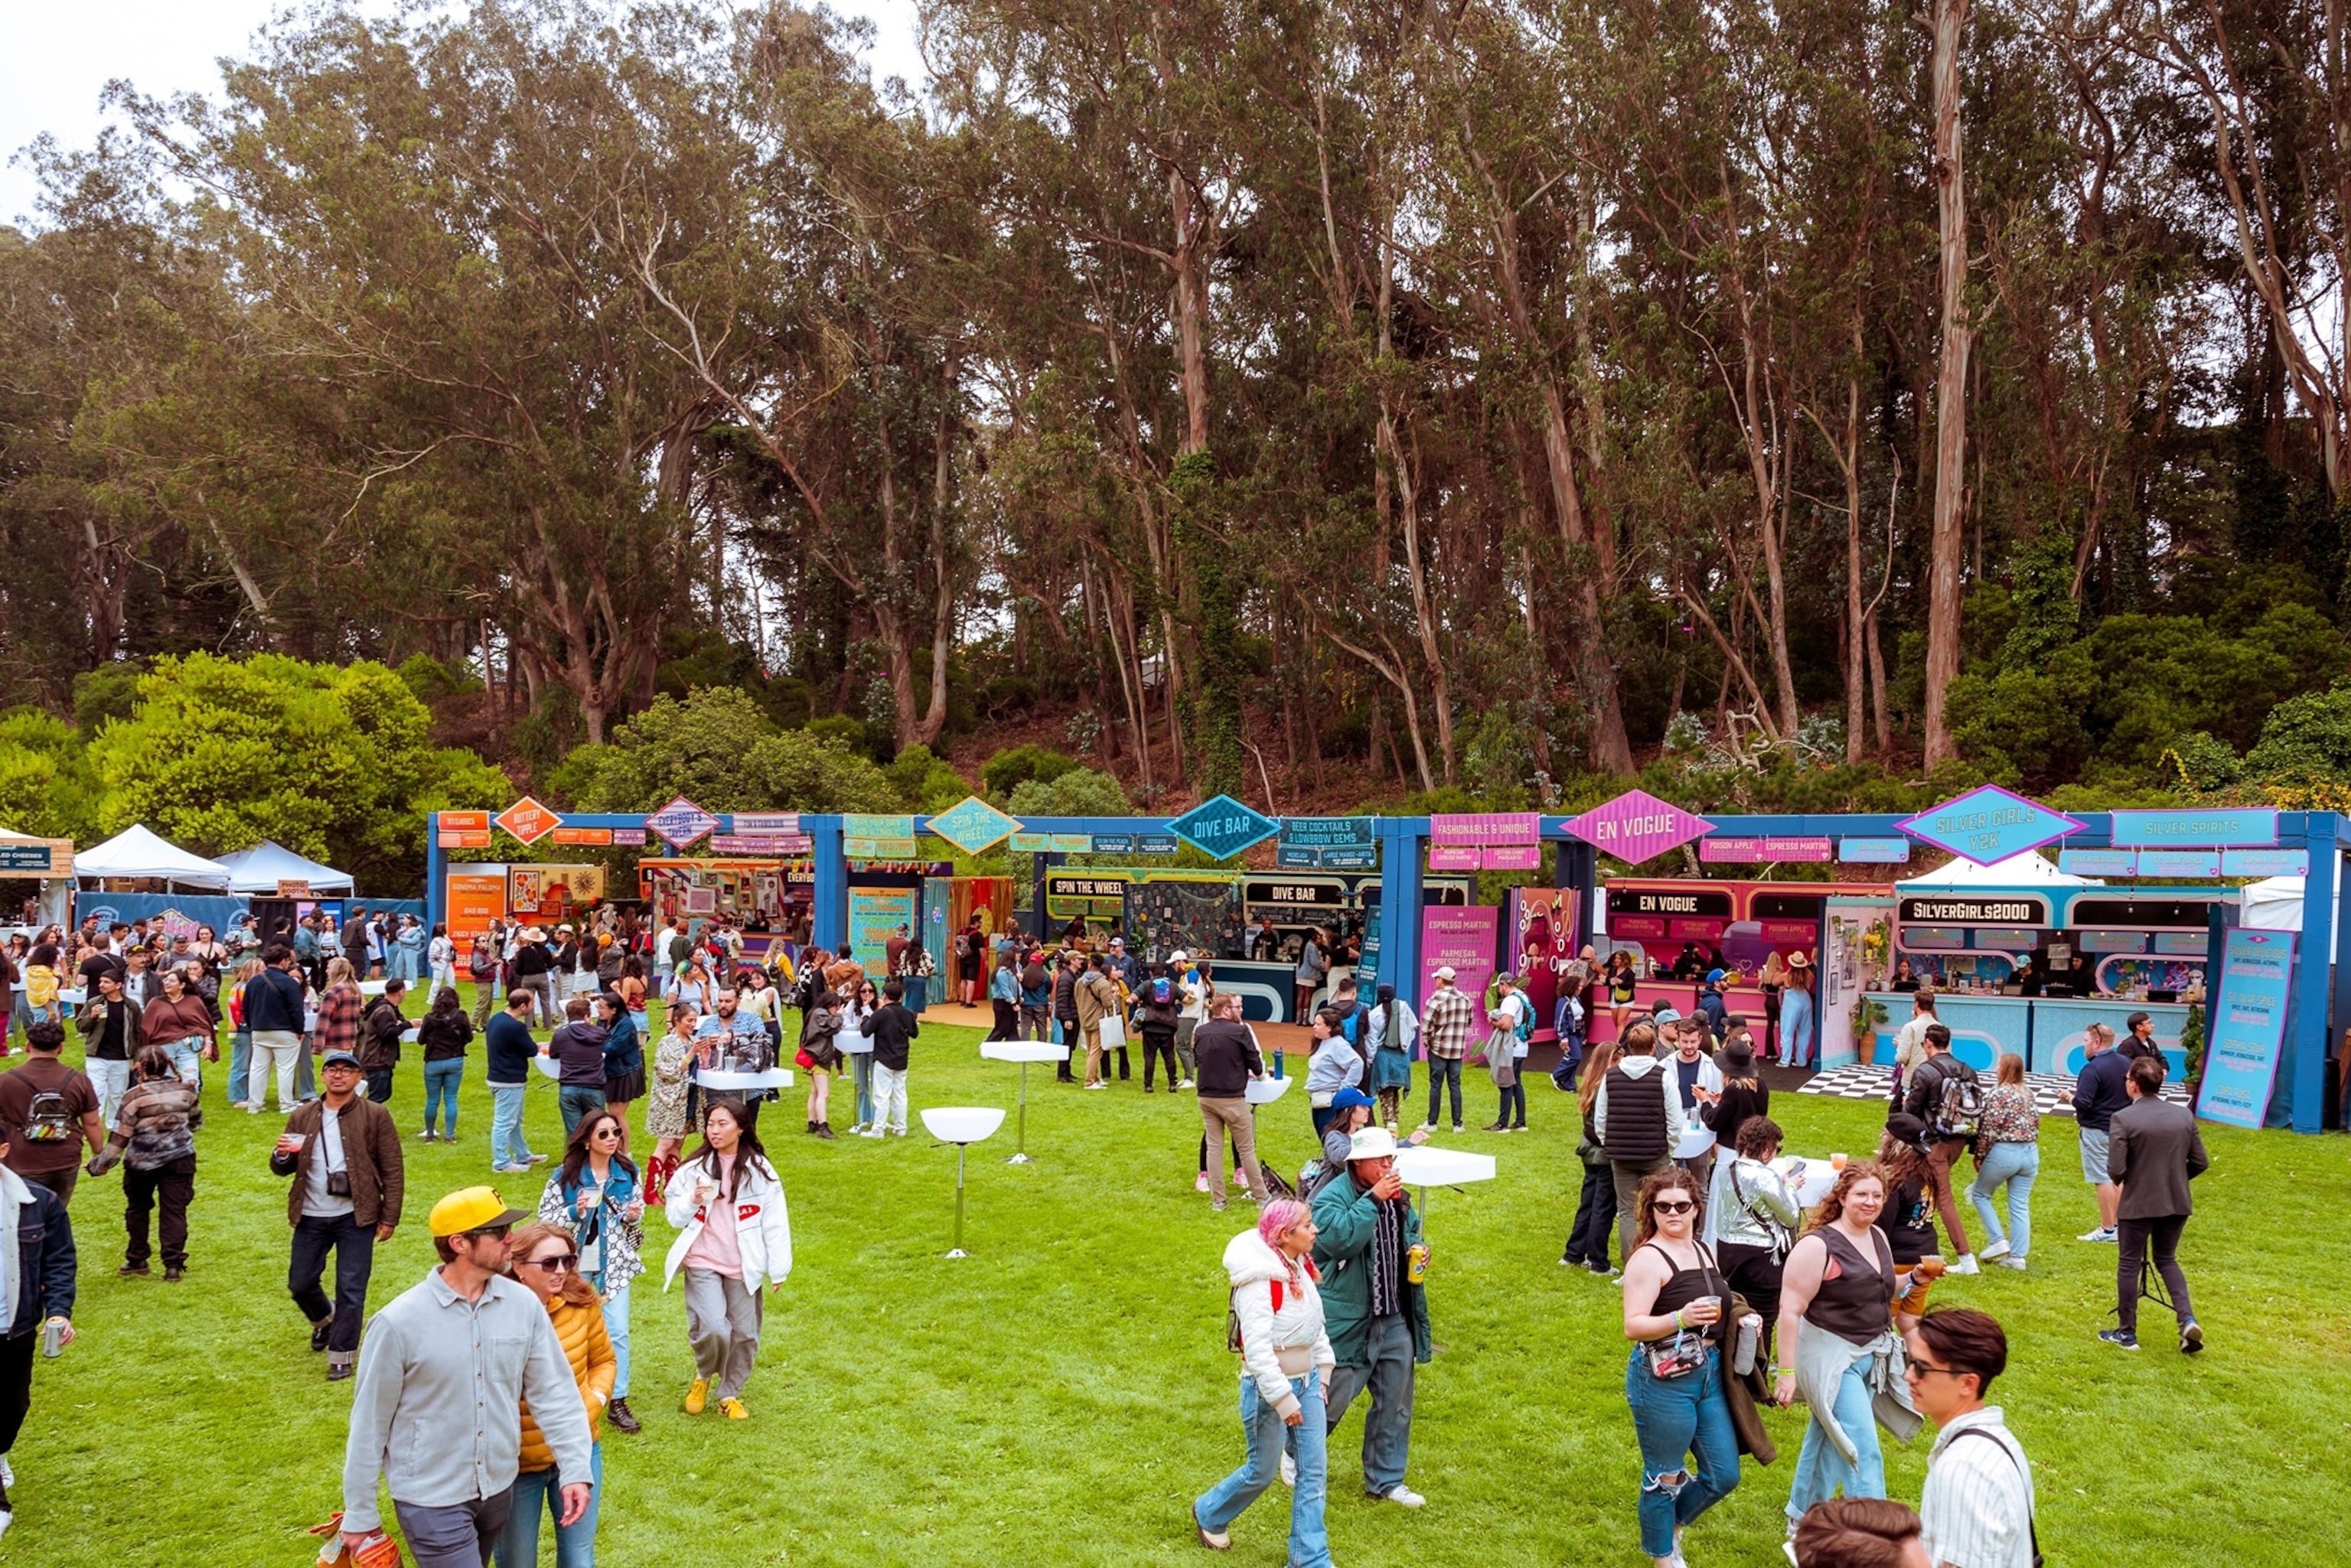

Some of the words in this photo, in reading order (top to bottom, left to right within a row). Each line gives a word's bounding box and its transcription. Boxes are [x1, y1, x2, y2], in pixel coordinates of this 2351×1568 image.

[514, 809, 541, 823] BUTTERY
[658, 810, 702, 826] EVERYBODY'S
[952, 815, 972, 828] SPIN
[975, 811, 992, 824] THE
[1936, 813, 1986, 833] SILVER
[1992, 807, 2036, 826] GIRLS
[517, 822, 538, 836] TIPPLE
[667, 826, 692, 838] TAVERN
[1194, 820, 1221, 838] DIVE
[1225, 816, 1250, 834] BAR
[1292, 822, 1307, 832] BEER
[1309, 821, 1351, 832] COCKTAILS
[1438, 824, 1489, 835] FASHIONABLE
[1492, 824, 1497, 833] &
[1499, 823, 1531, 835] UNIQUE
[1597, 821, 1616, 839] EN
[1623, 813, 1675, 838] VOGUE
[2146, 822, 2186, 834] SILVER
[2191, 821, 2239, 833] SPIRITS
[957, 827, 987, 841] WHEEL
[1295, 833, 1331, 843] LOWBROW
[1333, 833, 1356, 843] GEMS
[1970, 832, 2000, 851] Y2K
[1056, 881, 1075, 893] SPIN
[1076, 881, 1093, 894] THE
[1094, 882, 1123, 895] WHEEL
[1273, 886, 1293, 900] DIVE
[1296, 887, 1316, 901] BAR
[1639, 896, 1656, 911] EN
[1658, 896, 1697, 912] VOGUE
[1429, 921, 1462, 929] ESPRESSO
[1463, 921, 1491, 929] MARTINI
[2229, 945, 2252, 957] SILVER
[2253, 947, 2287, 960] DELICIOUS
[2258, 996, 2278, 1008] SPICE
[2248, 1042, 2265, 1055] SOUR
[491, 1188, 502, 1205] P
